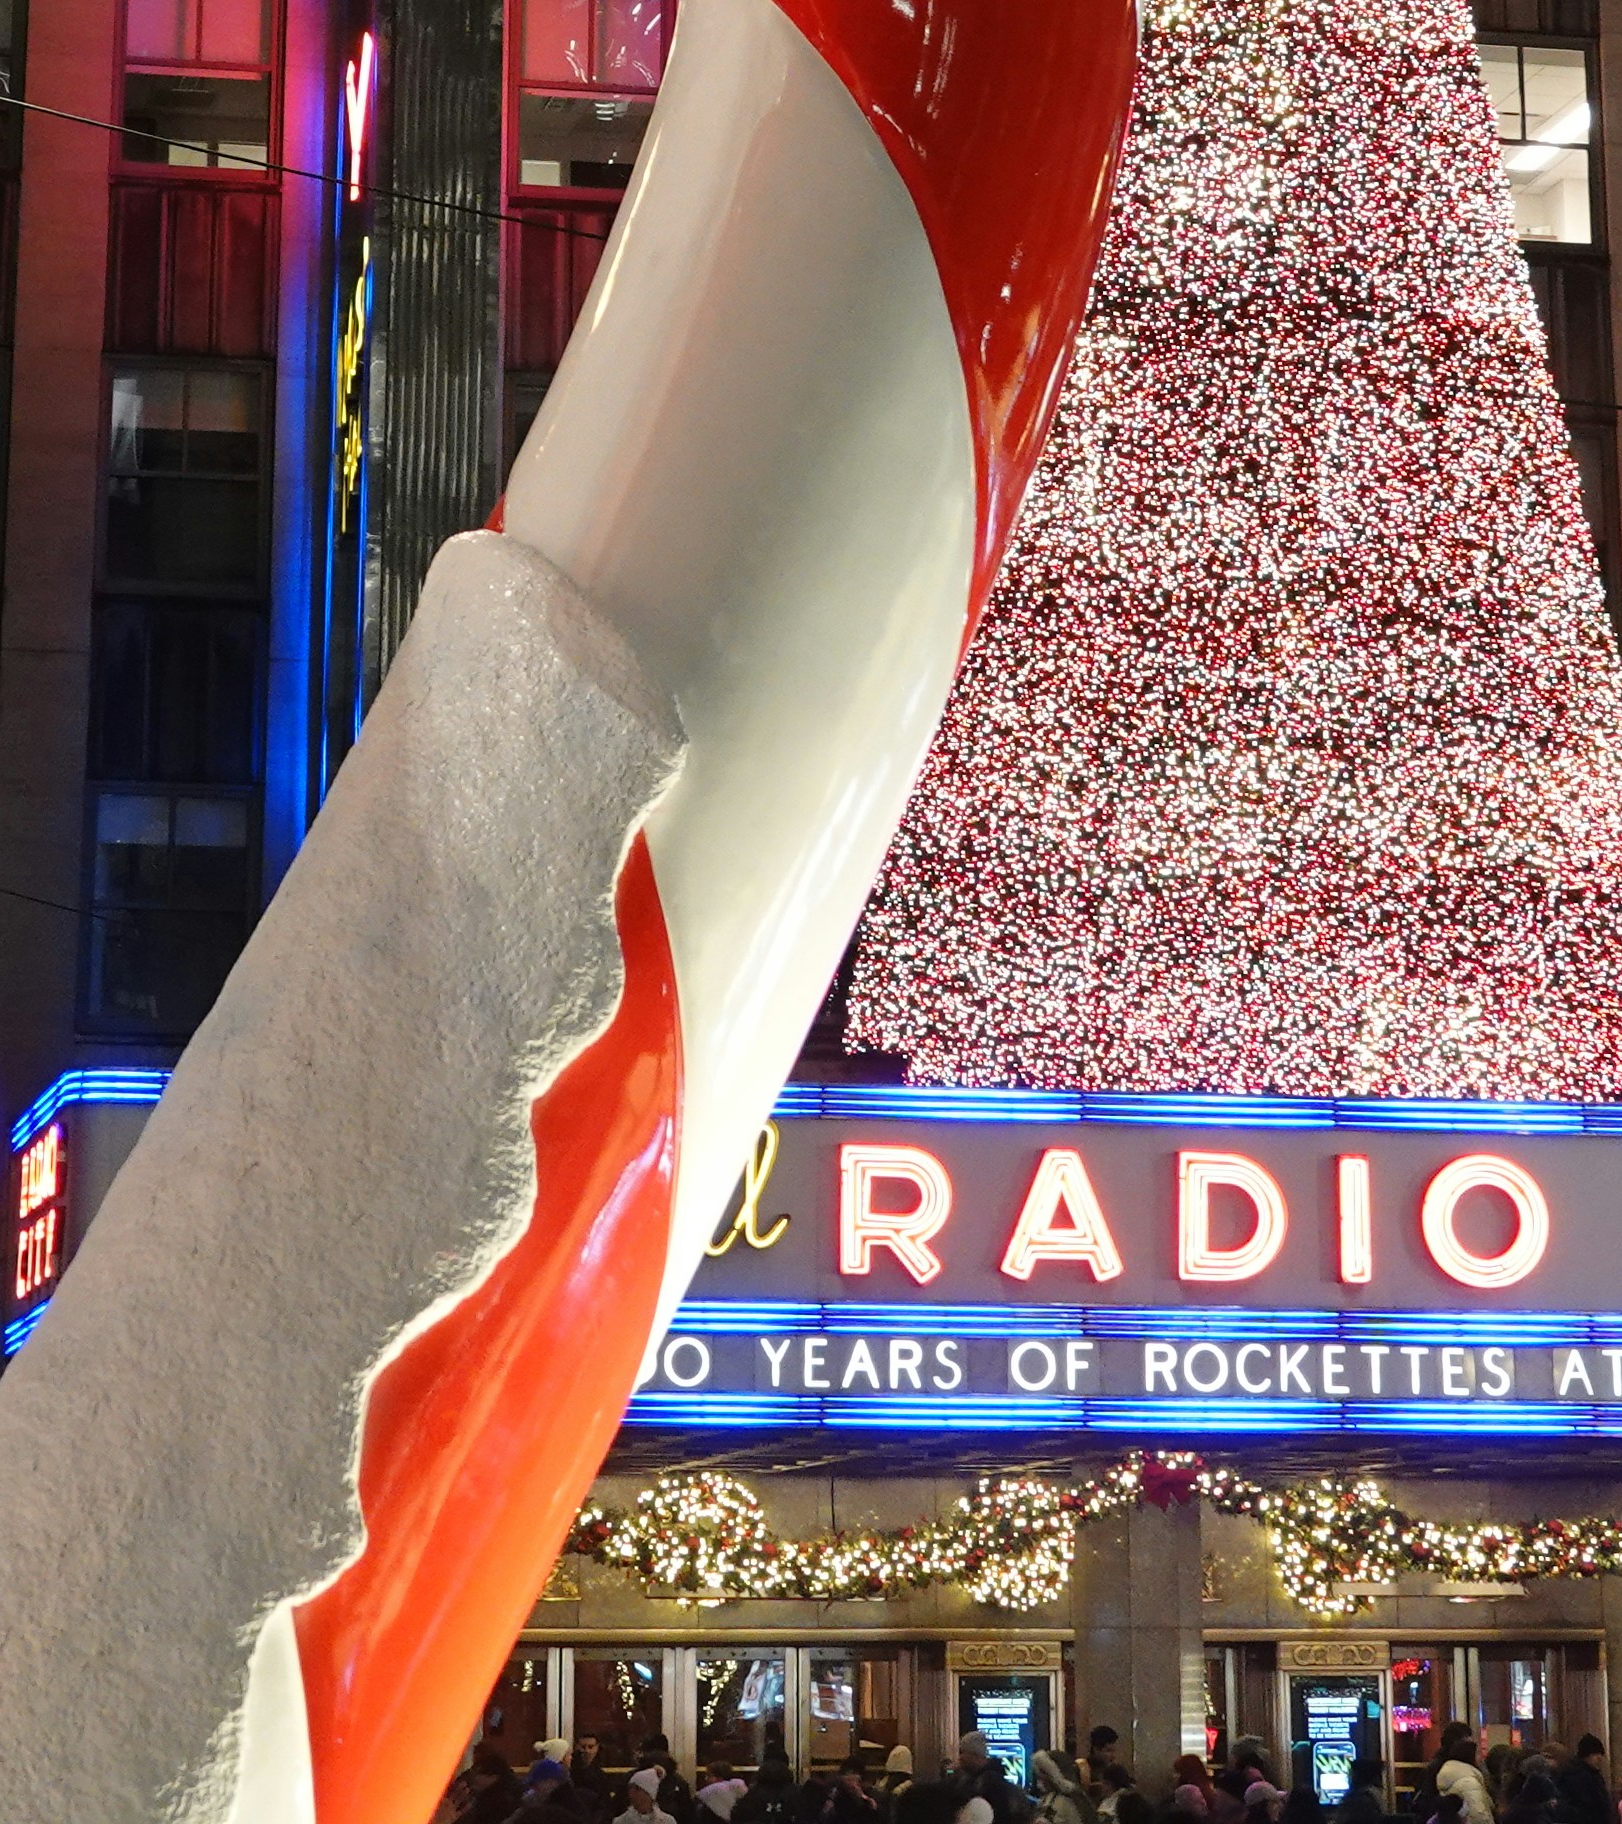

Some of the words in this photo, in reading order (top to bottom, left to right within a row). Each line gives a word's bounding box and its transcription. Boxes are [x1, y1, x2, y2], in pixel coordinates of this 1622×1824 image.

[838, 1143, 1551, 1289] RADIO
[759, 1336, 963, 1391] YEARS
[1009, 1339, 1095, 1393] OF
[1144, 1341, 1513, 1398] ROCKETTES
